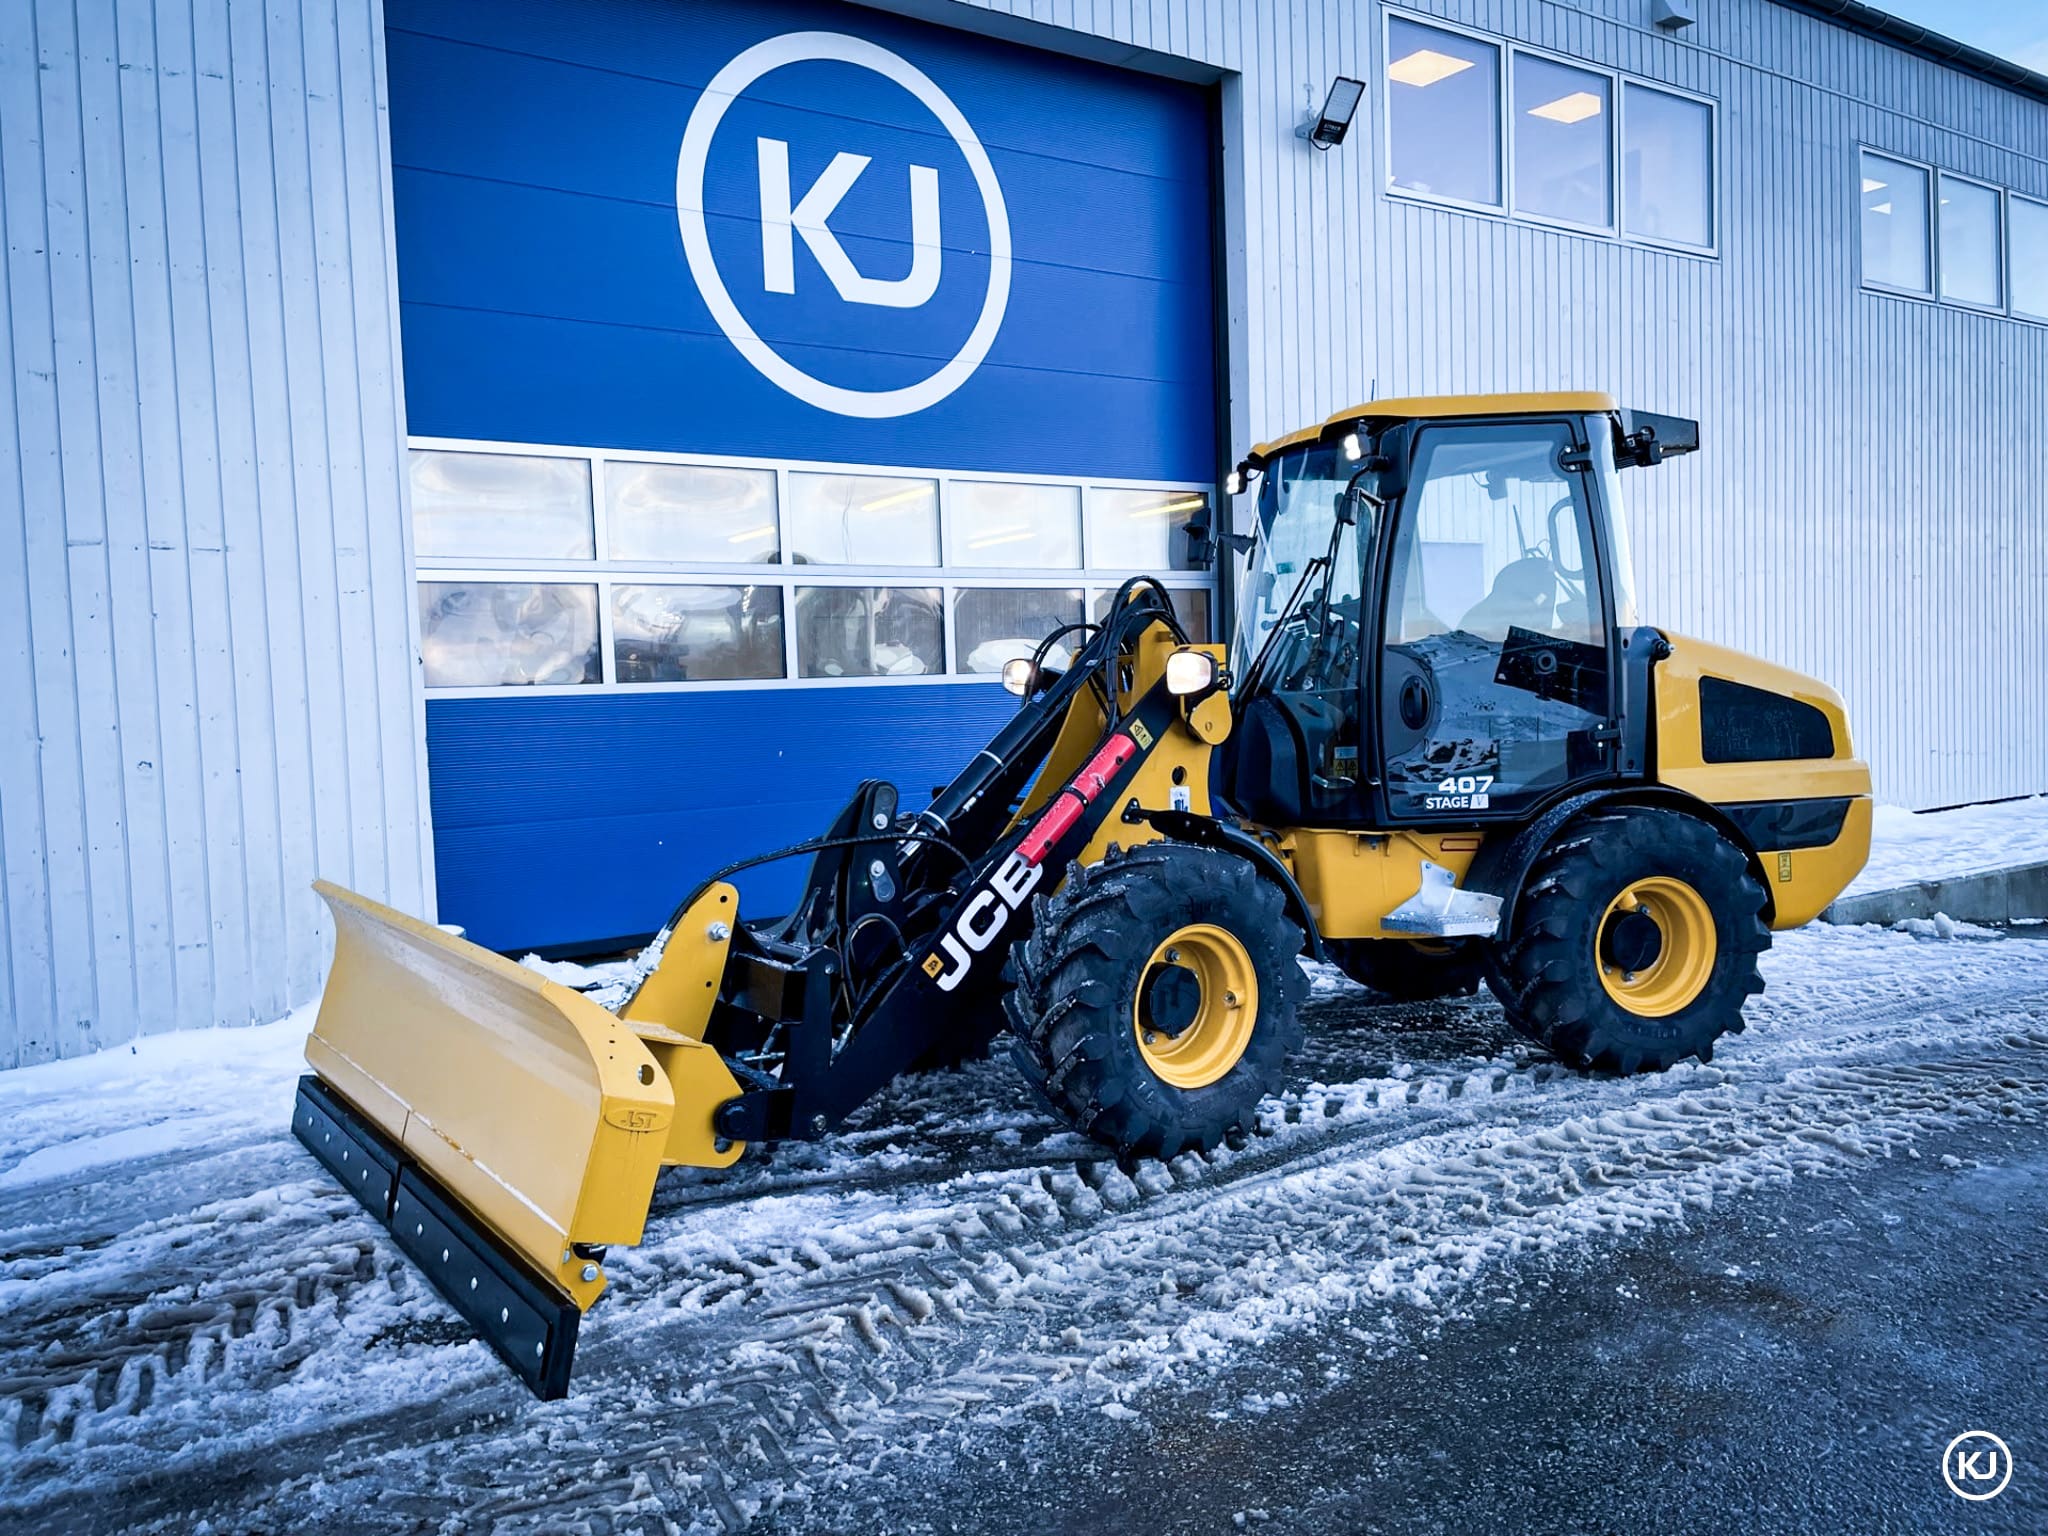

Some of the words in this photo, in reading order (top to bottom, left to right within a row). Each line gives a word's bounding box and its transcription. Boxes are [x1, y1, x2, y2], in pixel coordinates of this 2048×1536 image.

[757, 136, 942, 308] KJ
[1425, 796, 1469, 810] STAGE
[1438, 775, 1494, 794] 407
[936, 850, 1043, 992] JCB
